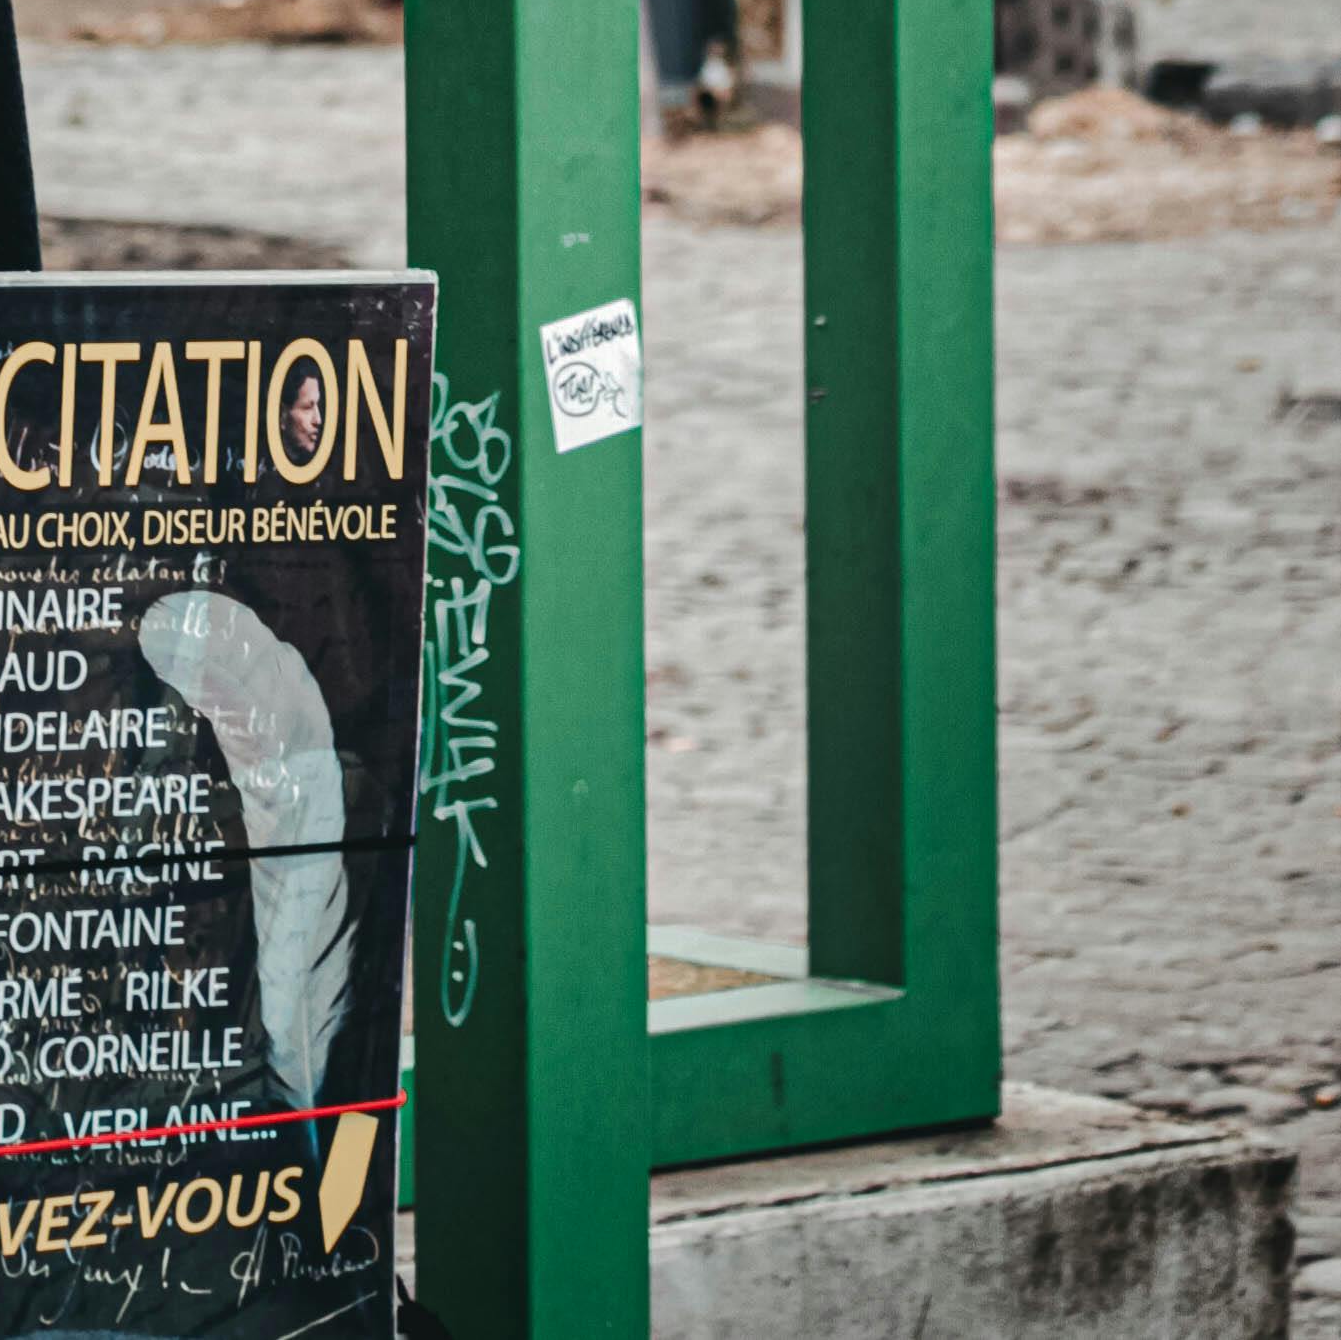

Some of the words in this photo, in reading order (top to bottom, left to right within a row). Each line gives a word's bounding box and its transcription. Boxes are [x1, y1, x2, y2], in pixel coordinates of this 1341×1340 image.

[36, 511, 136, 550] CHOIX,
[143, 508, 246, 546] DISEUR
[252, 499, 398, 543] BÉNÉVOLE
[79, 840, 226, 886] RACINE
[125, 966, 230, 1013] RILKE
[38, 1026, 244, 1079] CORNEILLE
